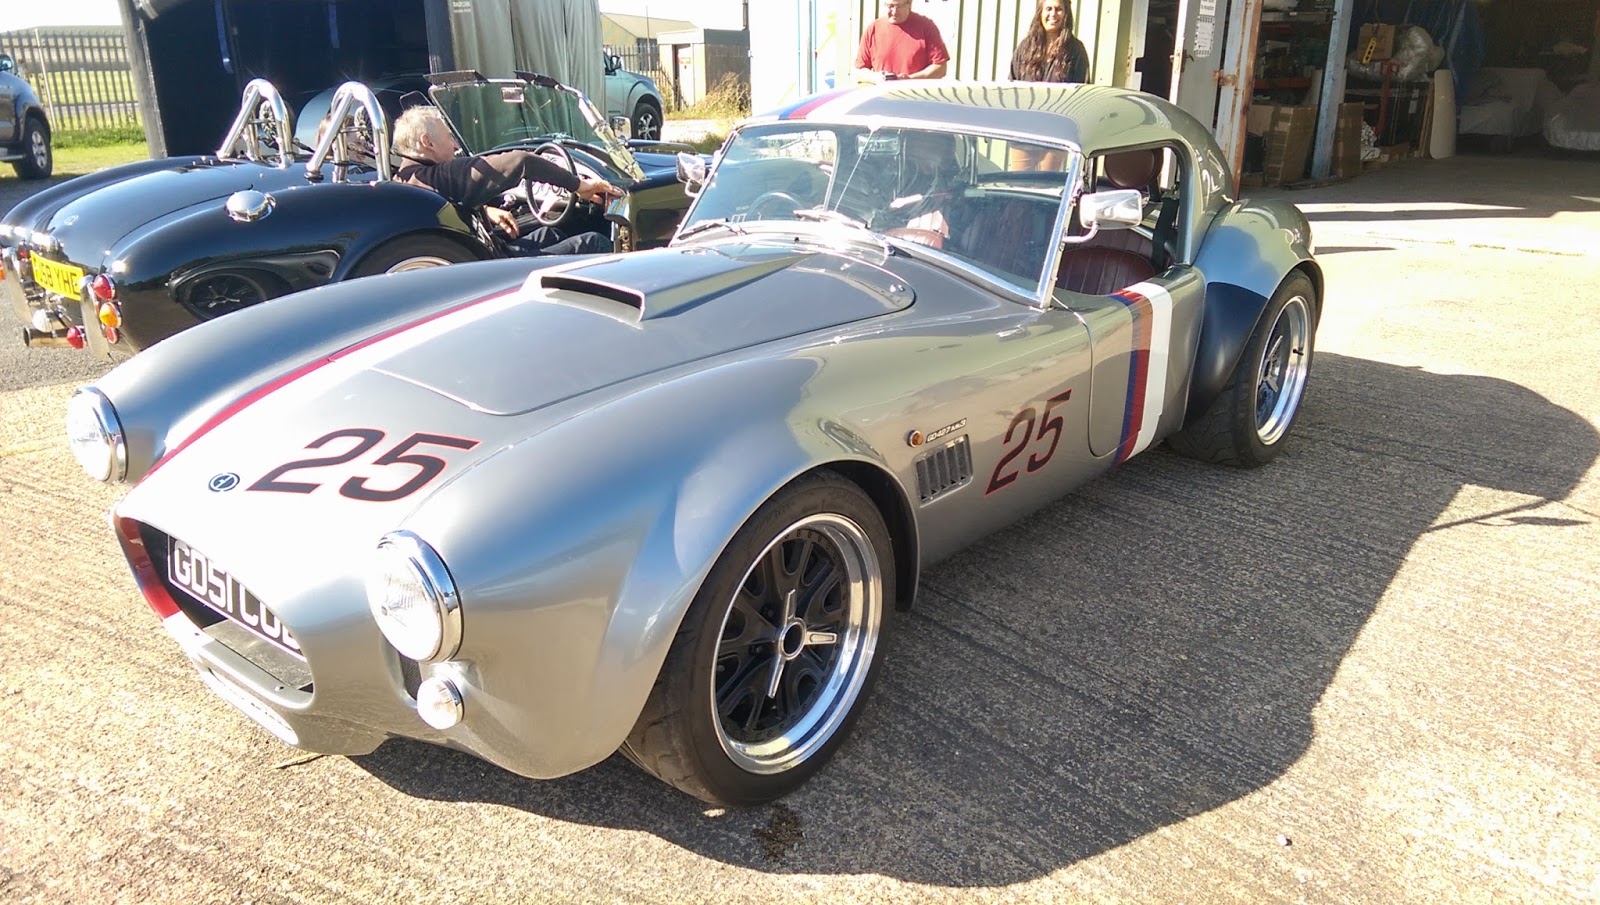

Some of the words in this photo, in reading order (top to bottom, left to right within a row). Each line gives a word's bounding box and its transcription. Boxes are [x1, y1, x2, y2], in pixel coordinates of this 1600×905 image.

[54, 268, 81, 295] YHE
[244, 427, 483, 502] 25
[985, 388, 1072, 496] 25
[174, 539, 234, 614] GD51
